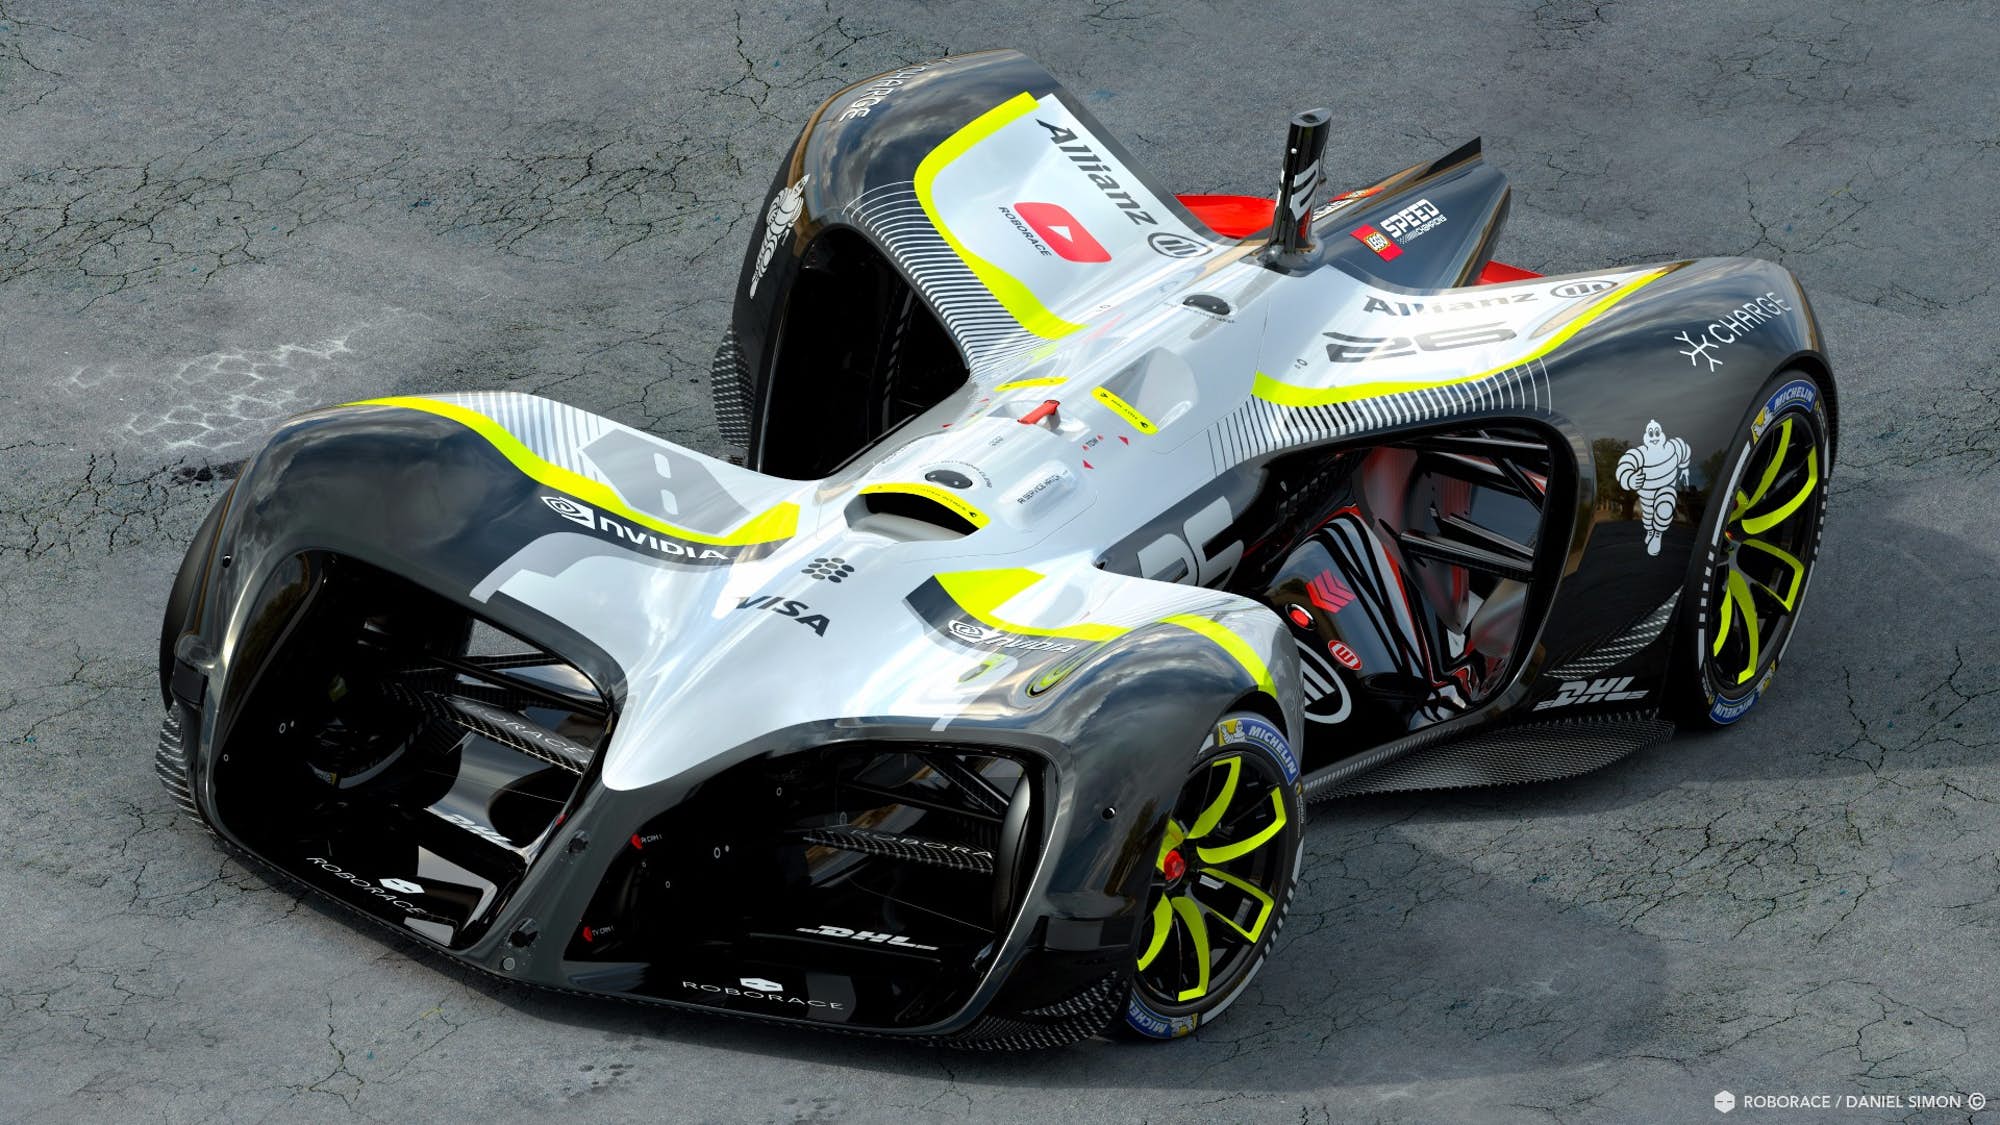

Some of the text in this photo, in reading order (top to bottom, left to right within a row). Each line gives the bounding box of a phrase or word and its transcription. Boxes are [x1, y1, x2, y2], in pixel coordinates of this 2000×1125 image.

[1035, 118, 1159, 226] Allianz
[998, 206, 1053, 257] ROBORACE
[1380, 199, 1440, 238] SPEED
[1365, 232, 1391, 252] LEGO
[1363, 294, 1539, 317] Allianz
[1708, 292, 1793, 344] CHARGE
[1774, 386, 1815, 410] MICHELIN
[735, 595, 832, 638] VISA
[1546, 676, 1636, 708] DHL
[1247, 724, 1299, 777] MICHELIN
[305, 857, 429, 915] ROBORACE
[817, 925, 918, 948] DHL
[682, 980, 845, 1011] ROBORACE
